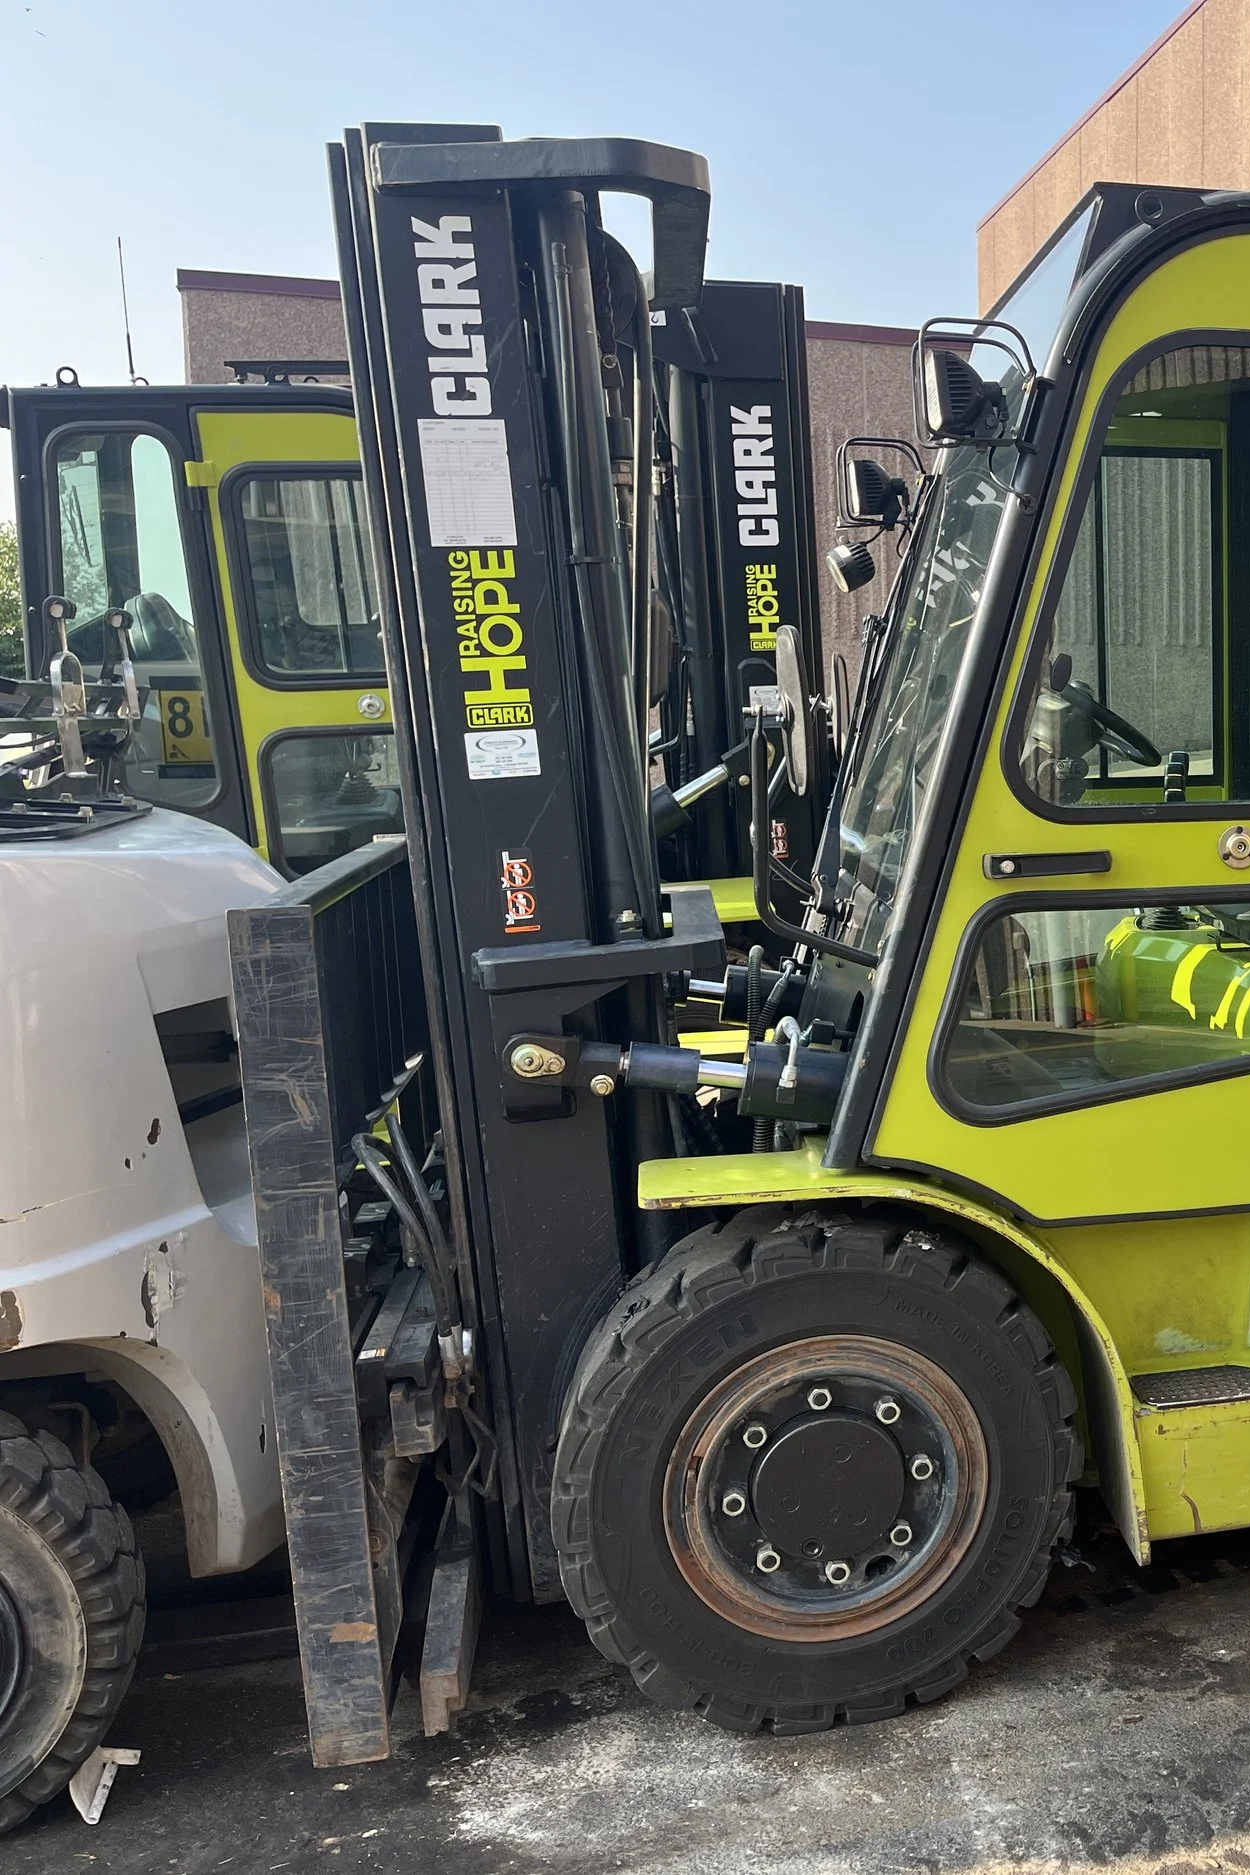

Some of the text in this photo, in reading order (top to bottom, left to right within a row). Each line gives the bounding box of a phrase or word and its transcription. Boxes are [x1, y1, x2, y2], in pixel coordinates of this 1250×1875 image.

[411, 216, 492, 416] CLARK
[730, 405, 779, 547] CLARK
[448, 550, 481, 656] RAISING
[460, 549, 531, 705] HOPE
[745, 564, 758, 616] RAISING
[749, 564, 779, 640] HOPE
[471, 706, 530, 726] CLARK
[618, 1312, 760, 1466] NEXEN
[893, 1297, 1015, 1400] MADE IN KOREA
